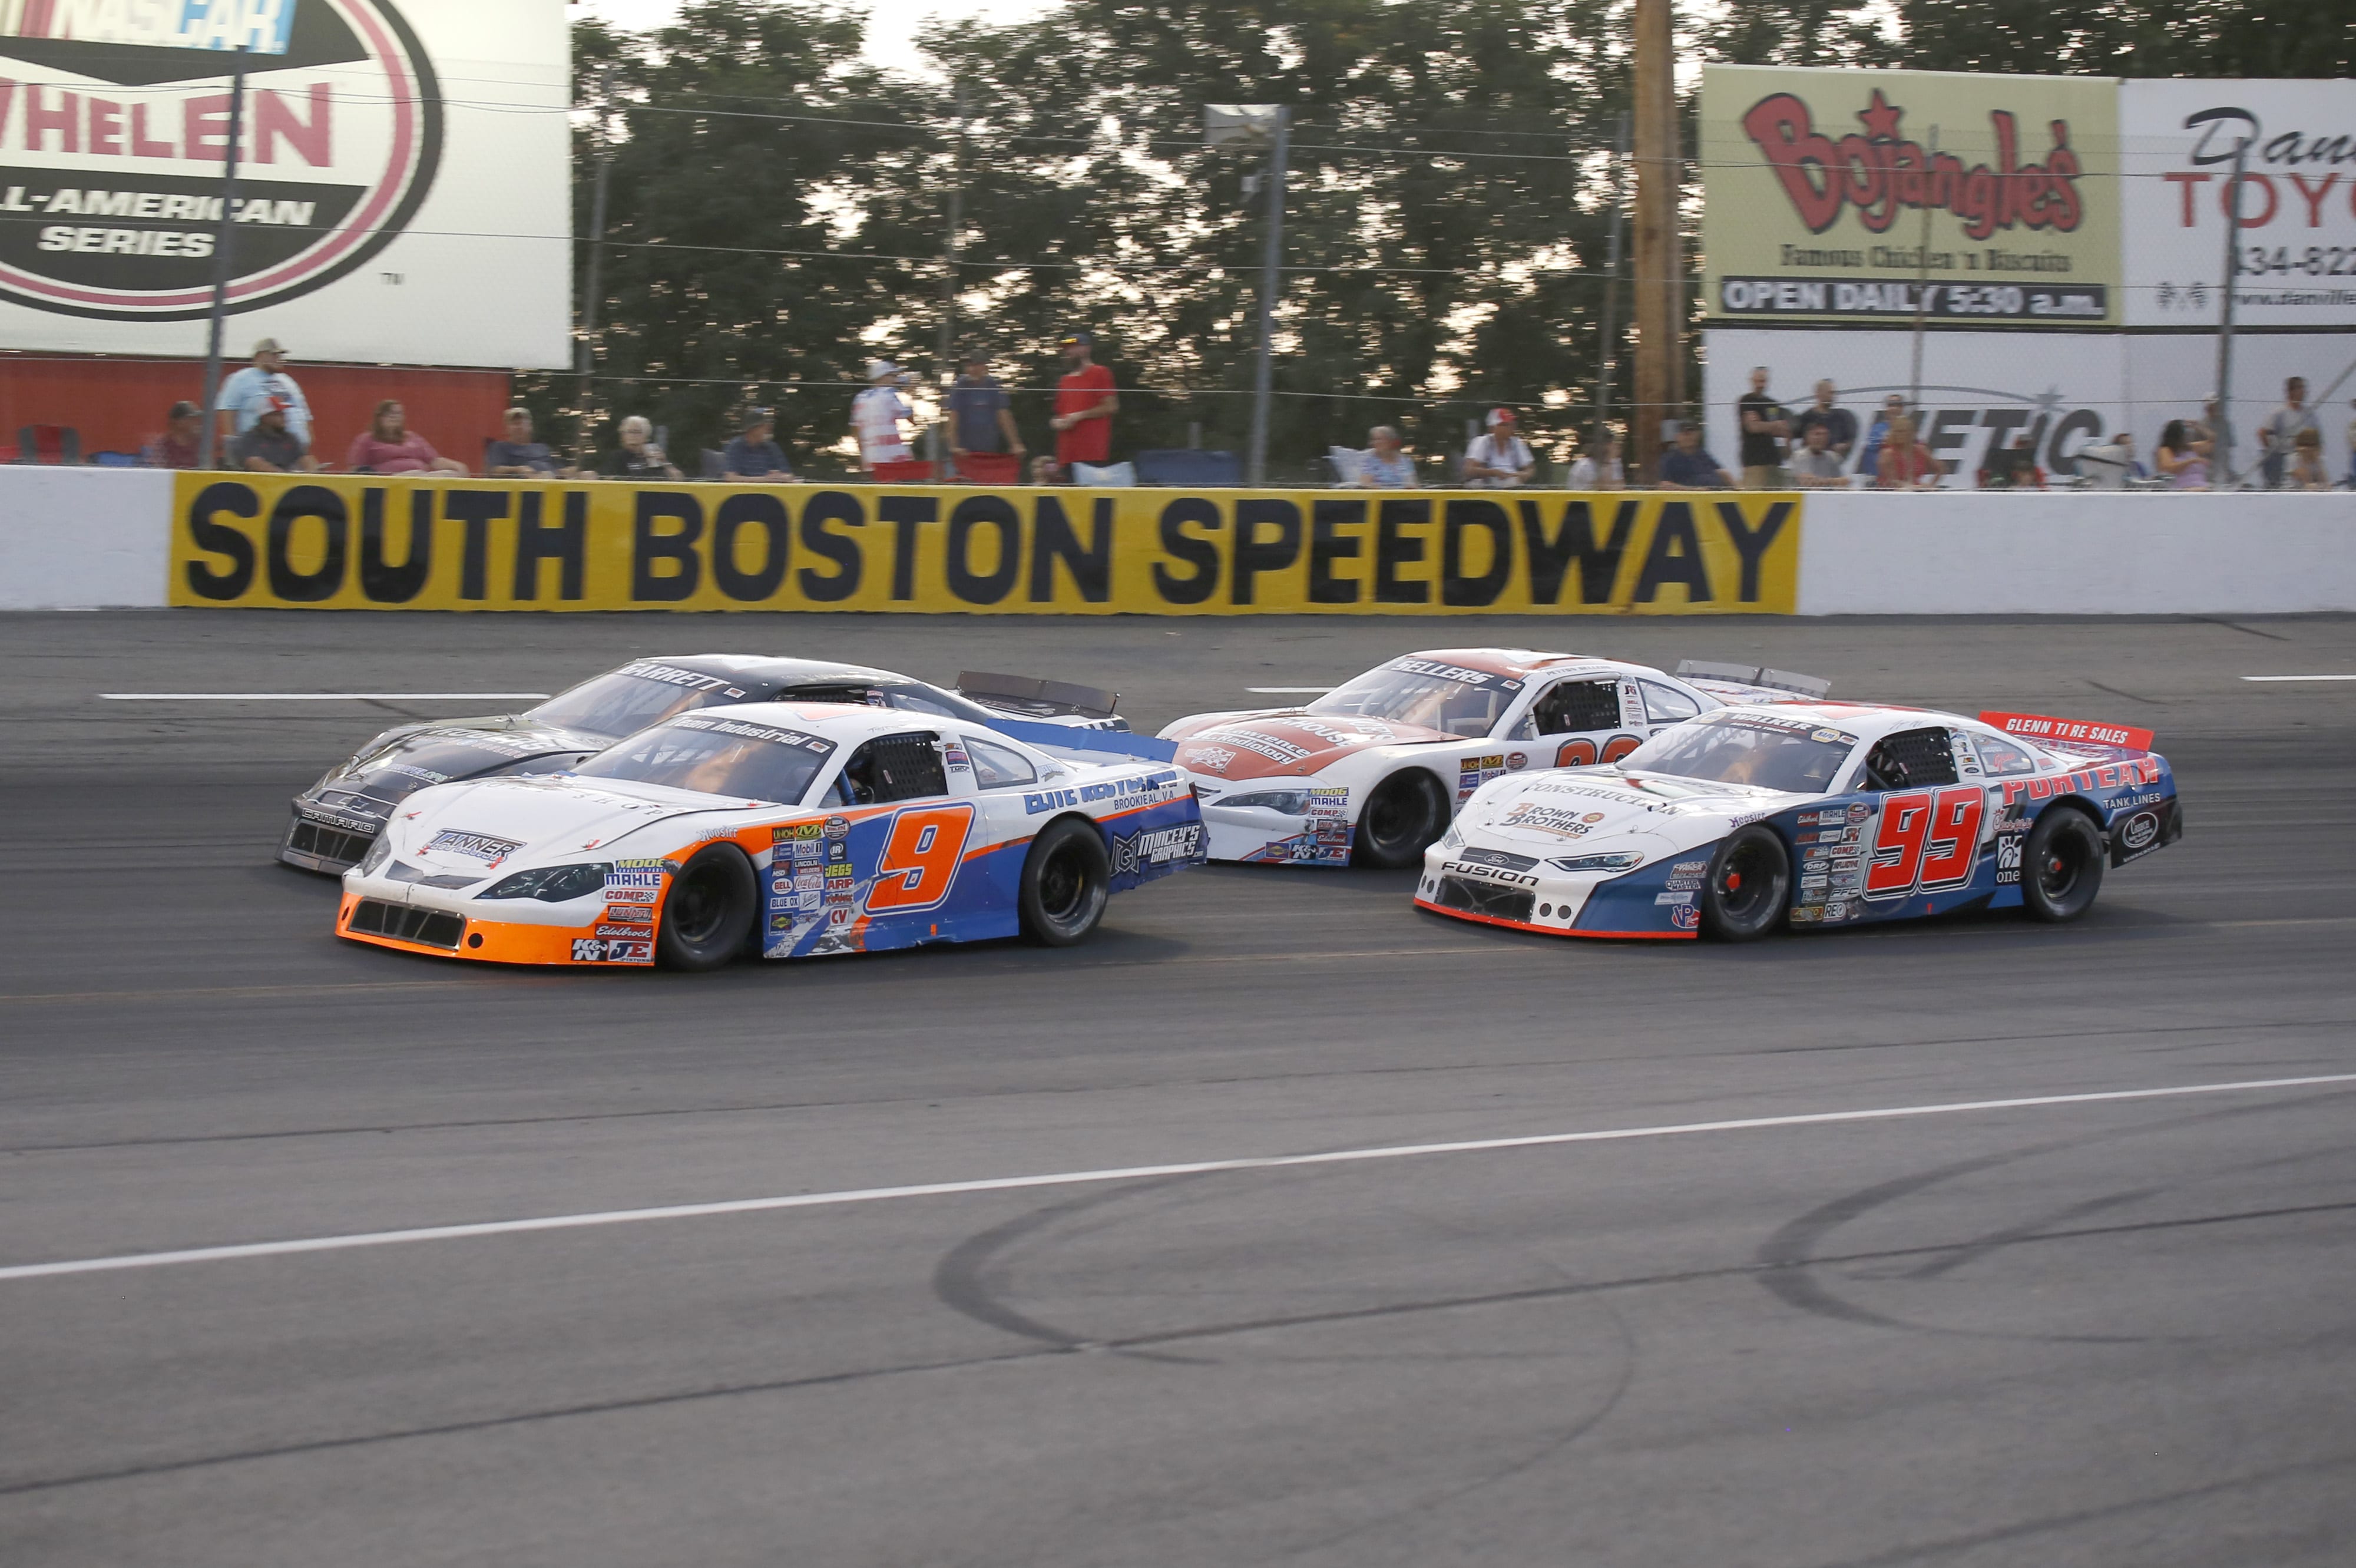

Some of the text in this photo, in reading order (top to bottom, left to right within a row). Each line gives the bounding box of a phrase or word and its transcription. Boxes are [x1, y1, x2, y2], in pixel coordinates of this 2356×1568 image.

[2184, 107, 2356, 166] Dan
[0, 187, 316, 226] L-AMERICAN
[2163, 171, 2356, 229] TOY
[37, 226, 216, 258] SERIES
[1722, 282, 1825, 310] OPEN
[1833, 283, 1940, 312] DAILY
[1946, 285, 2024, 313] 5:30
[185, 481, 1798, 607] SOUTH BOSTON SPEEDWAY
[616, 663, 732, 690] GARRETT
[1391, 660, 1495, 684] SELLERS
[668, 717, 813, 747] Team Industrial
[1730, 713, 1812, 731] WALKER
[2006, 718, 2052, 733] GLENN
[2089, 727, 2129, 744] SALES
[1225, 728, 1311, 756] Lawrence
[1815, 731, 1837, 739] NAPA
[1216, 735, 1297, 765] Radiology
[1311, 797, 1348, 806] MAHLE
[1507, 802, 1580, 821] BROWN
[2102, 793, 2160, 809] TANK LINES
[302, 807, 376, 833] CAMARO
[1497, 814, 1594, 835] BROTHERS
[1822, 809, 1846, 818] MAHLE
[431, 830, 524, 858] TANNER
[796, 843, 815, 854] Mobil
[1137, 825, 1201, 856] MINCEY'S
[1861, 784, 1988, 902] 99
[863, 801, 977, 918] 9
[1150, 841, 1197, 864] GRAPHICS
[606, 874, 661, 886] MAHLE
[825, 863, 853, 878] JEGS
[1441, 861, 1540, 886] FUSION
[1996, 870, 2020, 883] one
[605, 890, 644, 900] COMP
[775, 881, 791, 890] BELL
[826, 878, 853, 890] ARP
[1832, 887, 1859, 896] PFC
[772, 898, 787, 908] BLUE
[790, 897, 799, 906] OX
[832, 909, 848, 924] CV
[1673, 904, 1695, 927] VP
[596, 925, 651, 938] Edelbrock
[610, 942, 650, 960] JE
